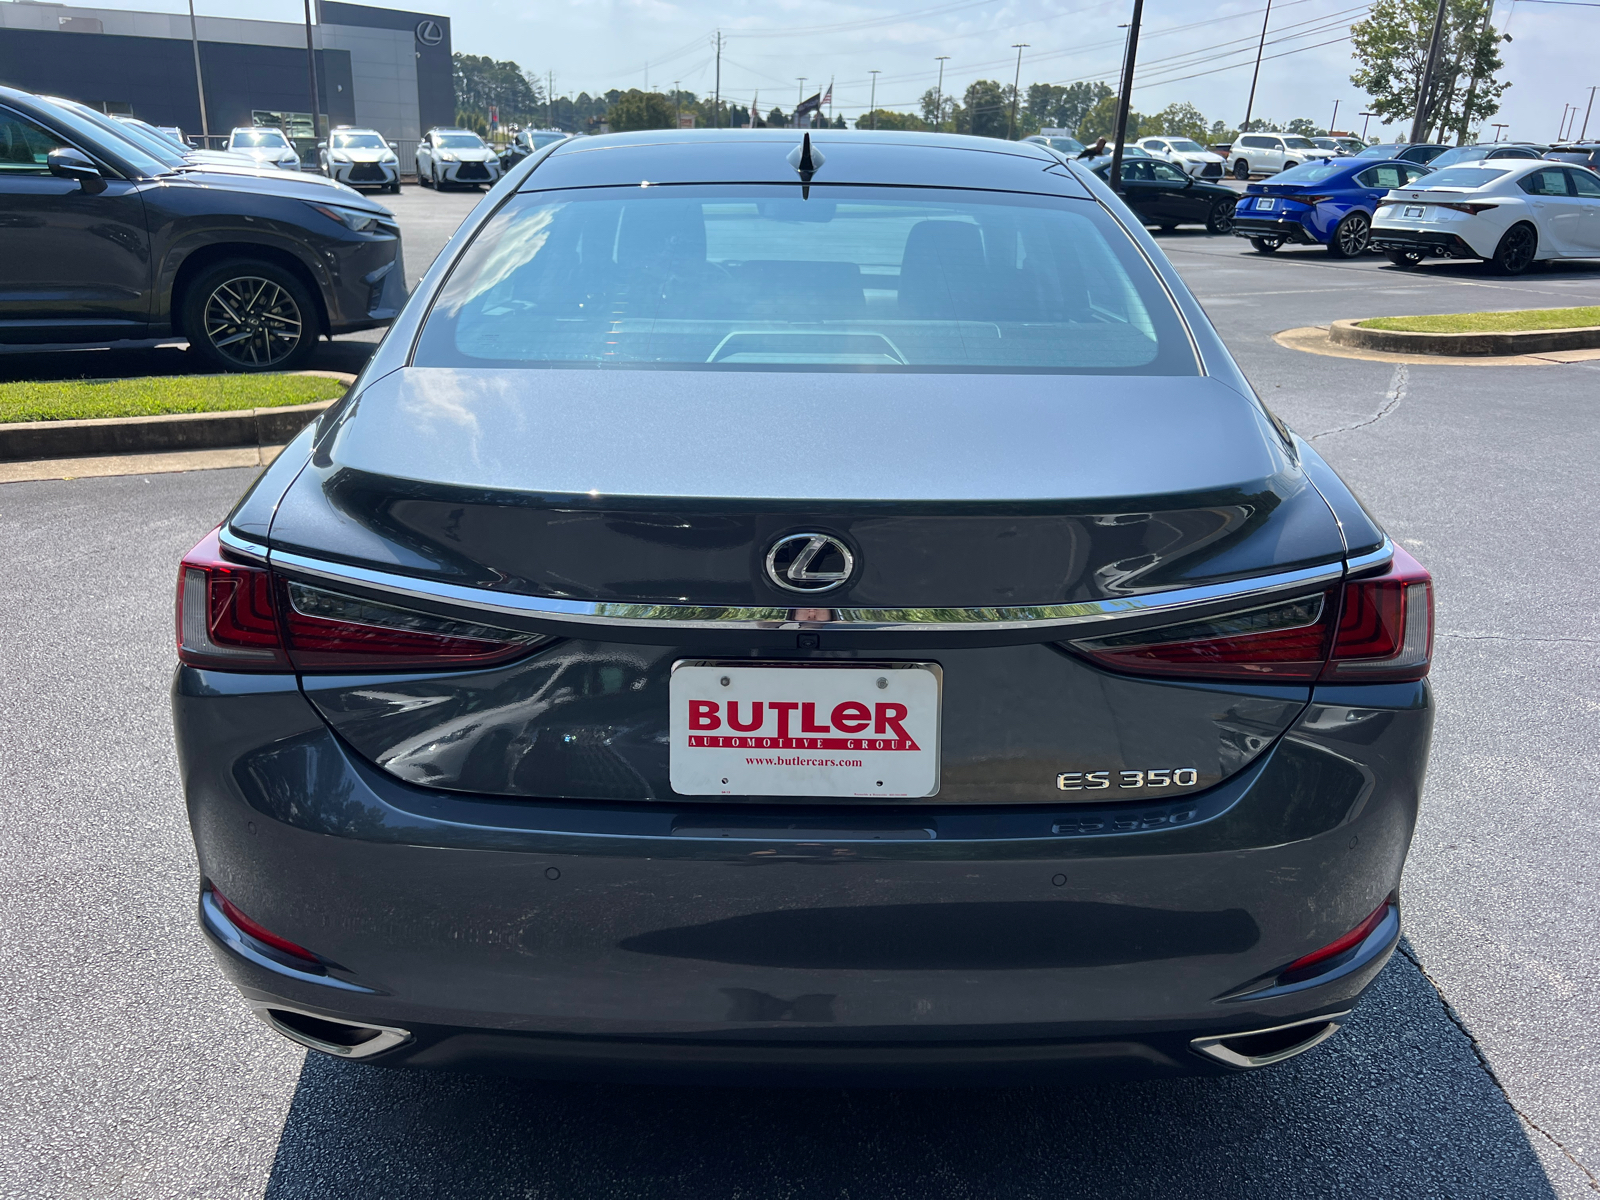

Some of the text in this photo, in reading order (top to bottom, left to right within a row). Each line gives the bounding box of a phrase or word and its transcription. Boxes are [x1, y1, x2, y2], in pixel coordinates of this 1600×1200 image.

[689, 736, 913, 750] AUTOMOTIVE GROUP
[745, 756, 863, 768] www.butlercars.com
[1056, 767, 1198, 791] ES 350
